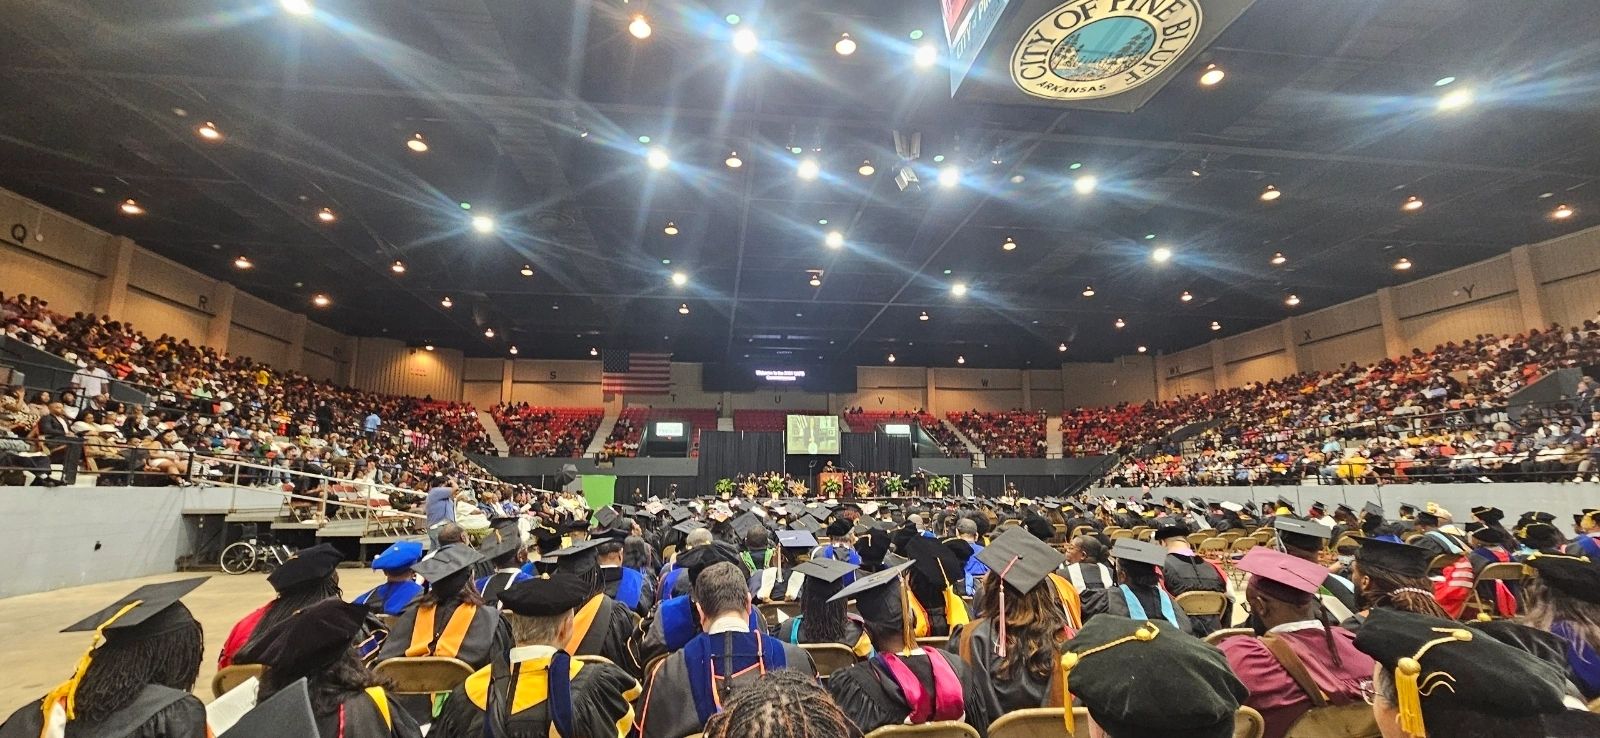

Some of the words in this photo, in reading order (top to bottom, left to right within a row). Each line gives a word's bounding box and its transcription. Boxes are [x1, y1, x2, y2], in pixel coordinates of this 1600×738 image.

[1020, 29, 1057, 80] CITY
[1053, 0, 1098, 30] OF
[1124, 16, 1192, 86] BLUFF
[1036, 80, 1106, 93] ARKANSAS
[11, 224, 26, 244] Q
[1462, 283, 1475, 299] Y
[199, 295, 208, 309] R
[1304, 328, 1312, 341] X
[550, 370, 557, 380] S
[981, 378, 989, 387] W
[670, 393, 677, 402] T
[774, 395, 781, 404] U
[878, 396, 885, 405] V
